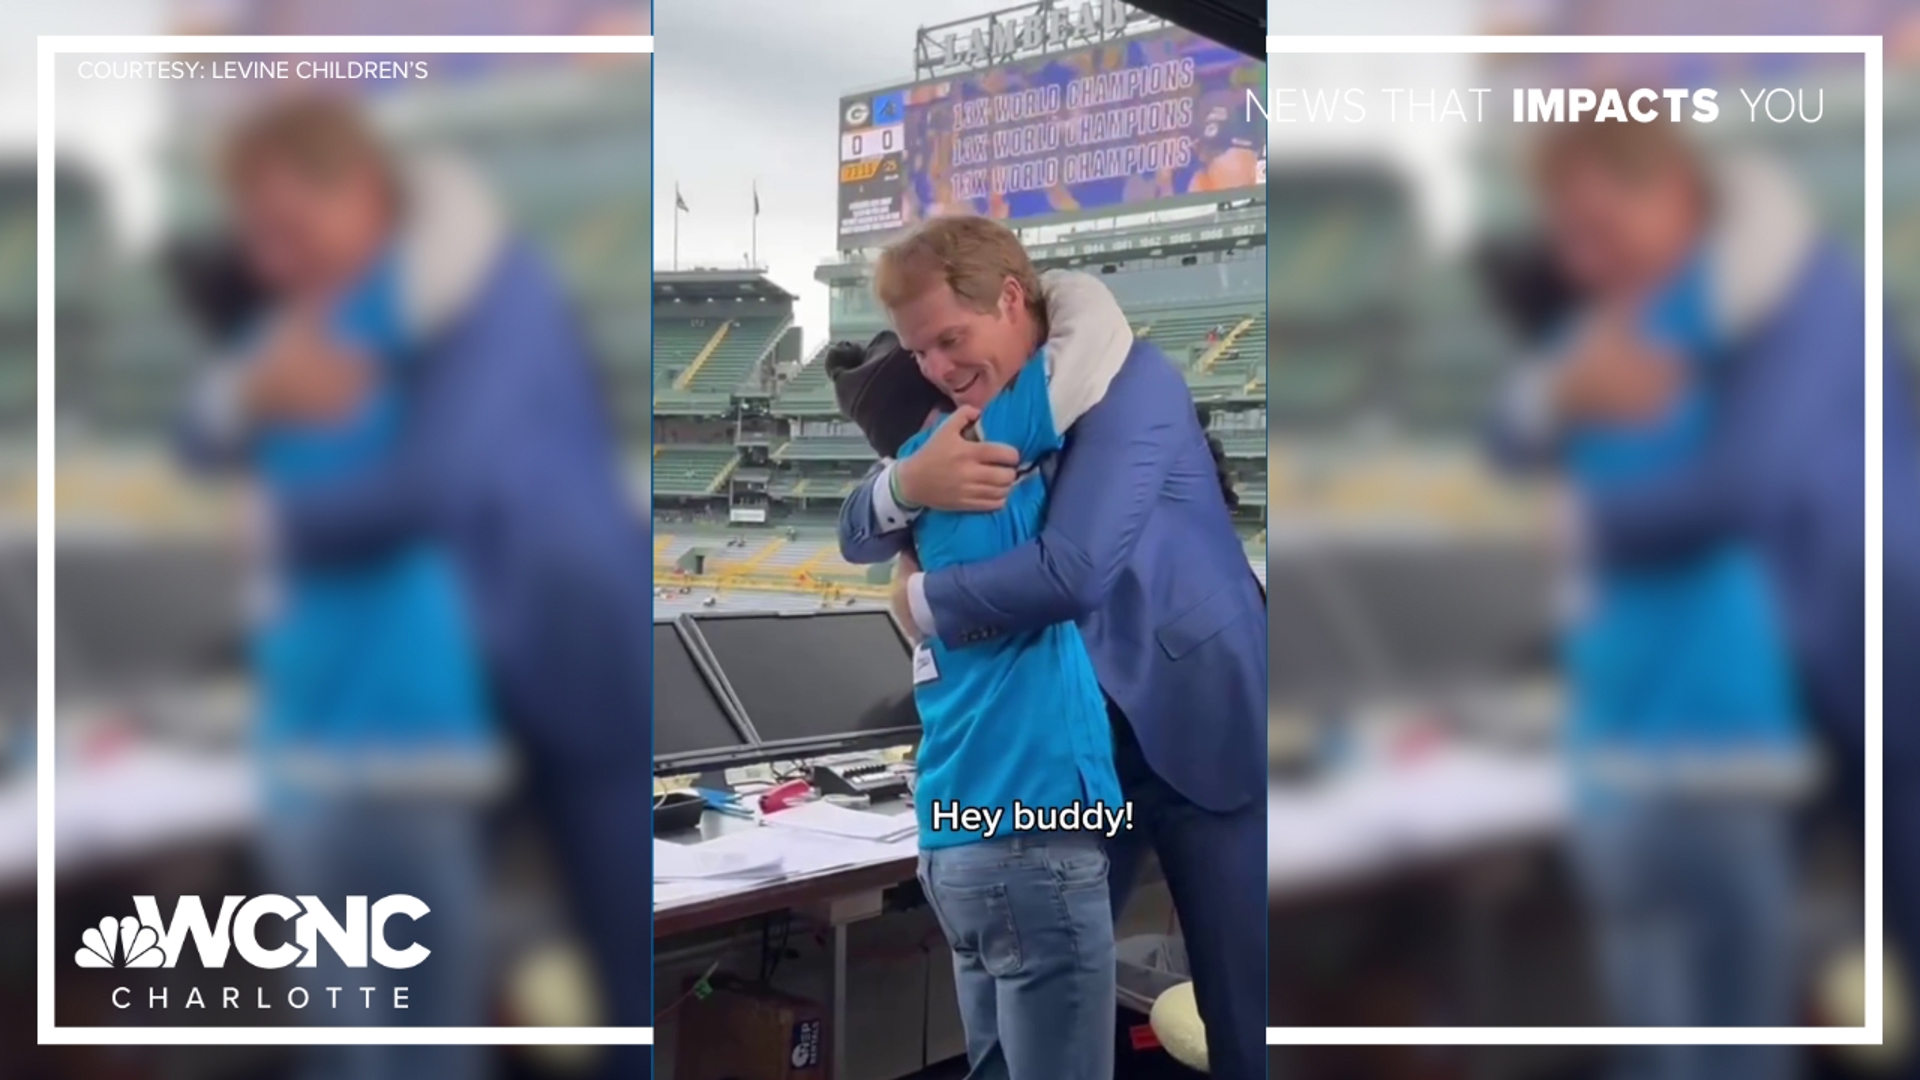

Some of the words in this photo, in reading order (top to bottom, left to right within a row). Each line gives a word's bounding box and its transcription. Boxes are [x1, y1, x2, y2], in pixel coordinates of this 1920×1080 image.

[943, 0, 1127, 68] LAMBEAU
[953, 97, 989, 131] 13X
[994, 84, 1061, 122] WORLD
[1066, 57, 1194, 110] CHAMPIONS
[952, 133, 988, 166] 13X
[993, 121, 1059, 159] WORLD
[1064, 97, 1192, 147] CHAMPIONS
[951, 168, 987, 200] 13X
[991, 157, 1058, 195] WORLD
[1063, 136, 1191, 184] CHAMPIONS
